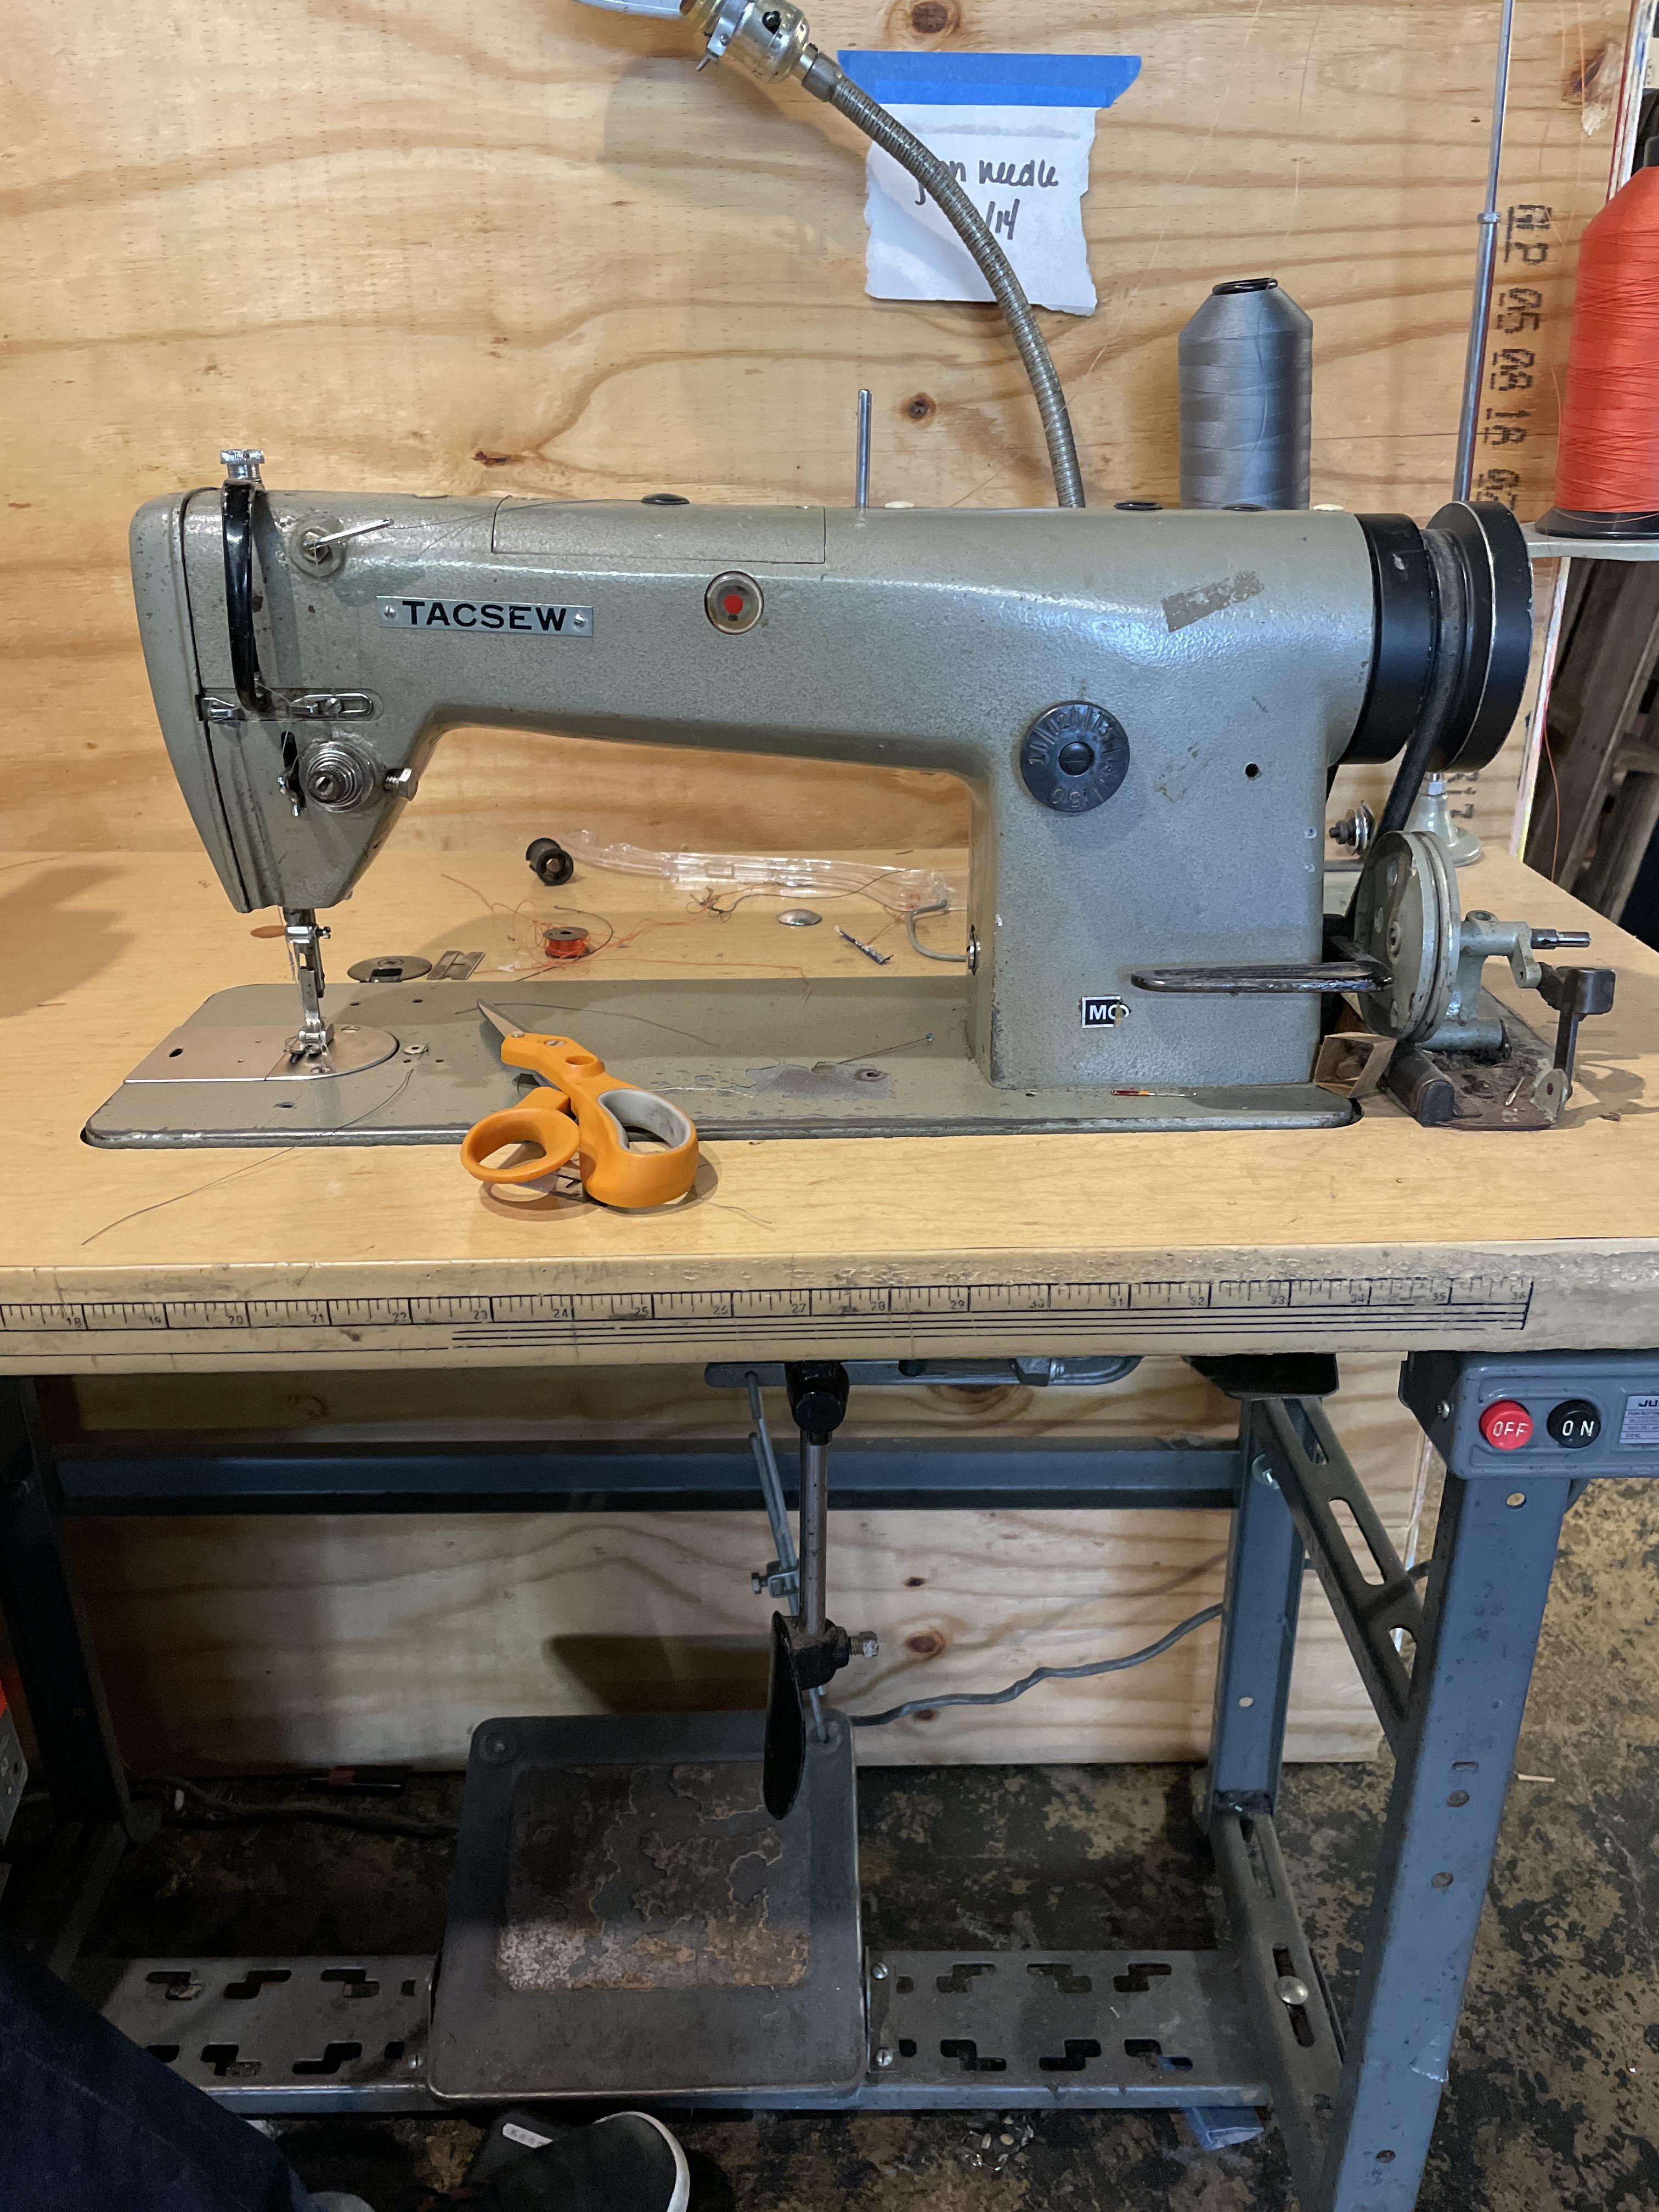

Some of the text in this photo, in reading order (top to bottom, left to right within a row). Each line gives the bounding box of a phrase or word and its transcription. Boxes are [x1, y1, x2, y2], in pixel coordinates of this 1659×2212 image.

[979, 159, 1059, 188] needle
[402, 600, 567, 631] TACSEW
[310, 1313, 324, 1323] 21
[392, 1312, 407, 1322] 22
[473, 1310, 488, 1320] 23
[634, 1306, 649, 1316] 25
[792, 1303, 806, 1313] 27
[950, 1300, 964, 1310] 29
[1110, 1297, 1122, 1307] 31
[1271, 1295, 1285, 1305] 33
[1351, 1294, 1364, 1303] 34
[1432, 1292, 1446, 1301] 35
[1492, 1420, 1528, 1437] OFF
[1562, 1419, 1595, 1437] ON
